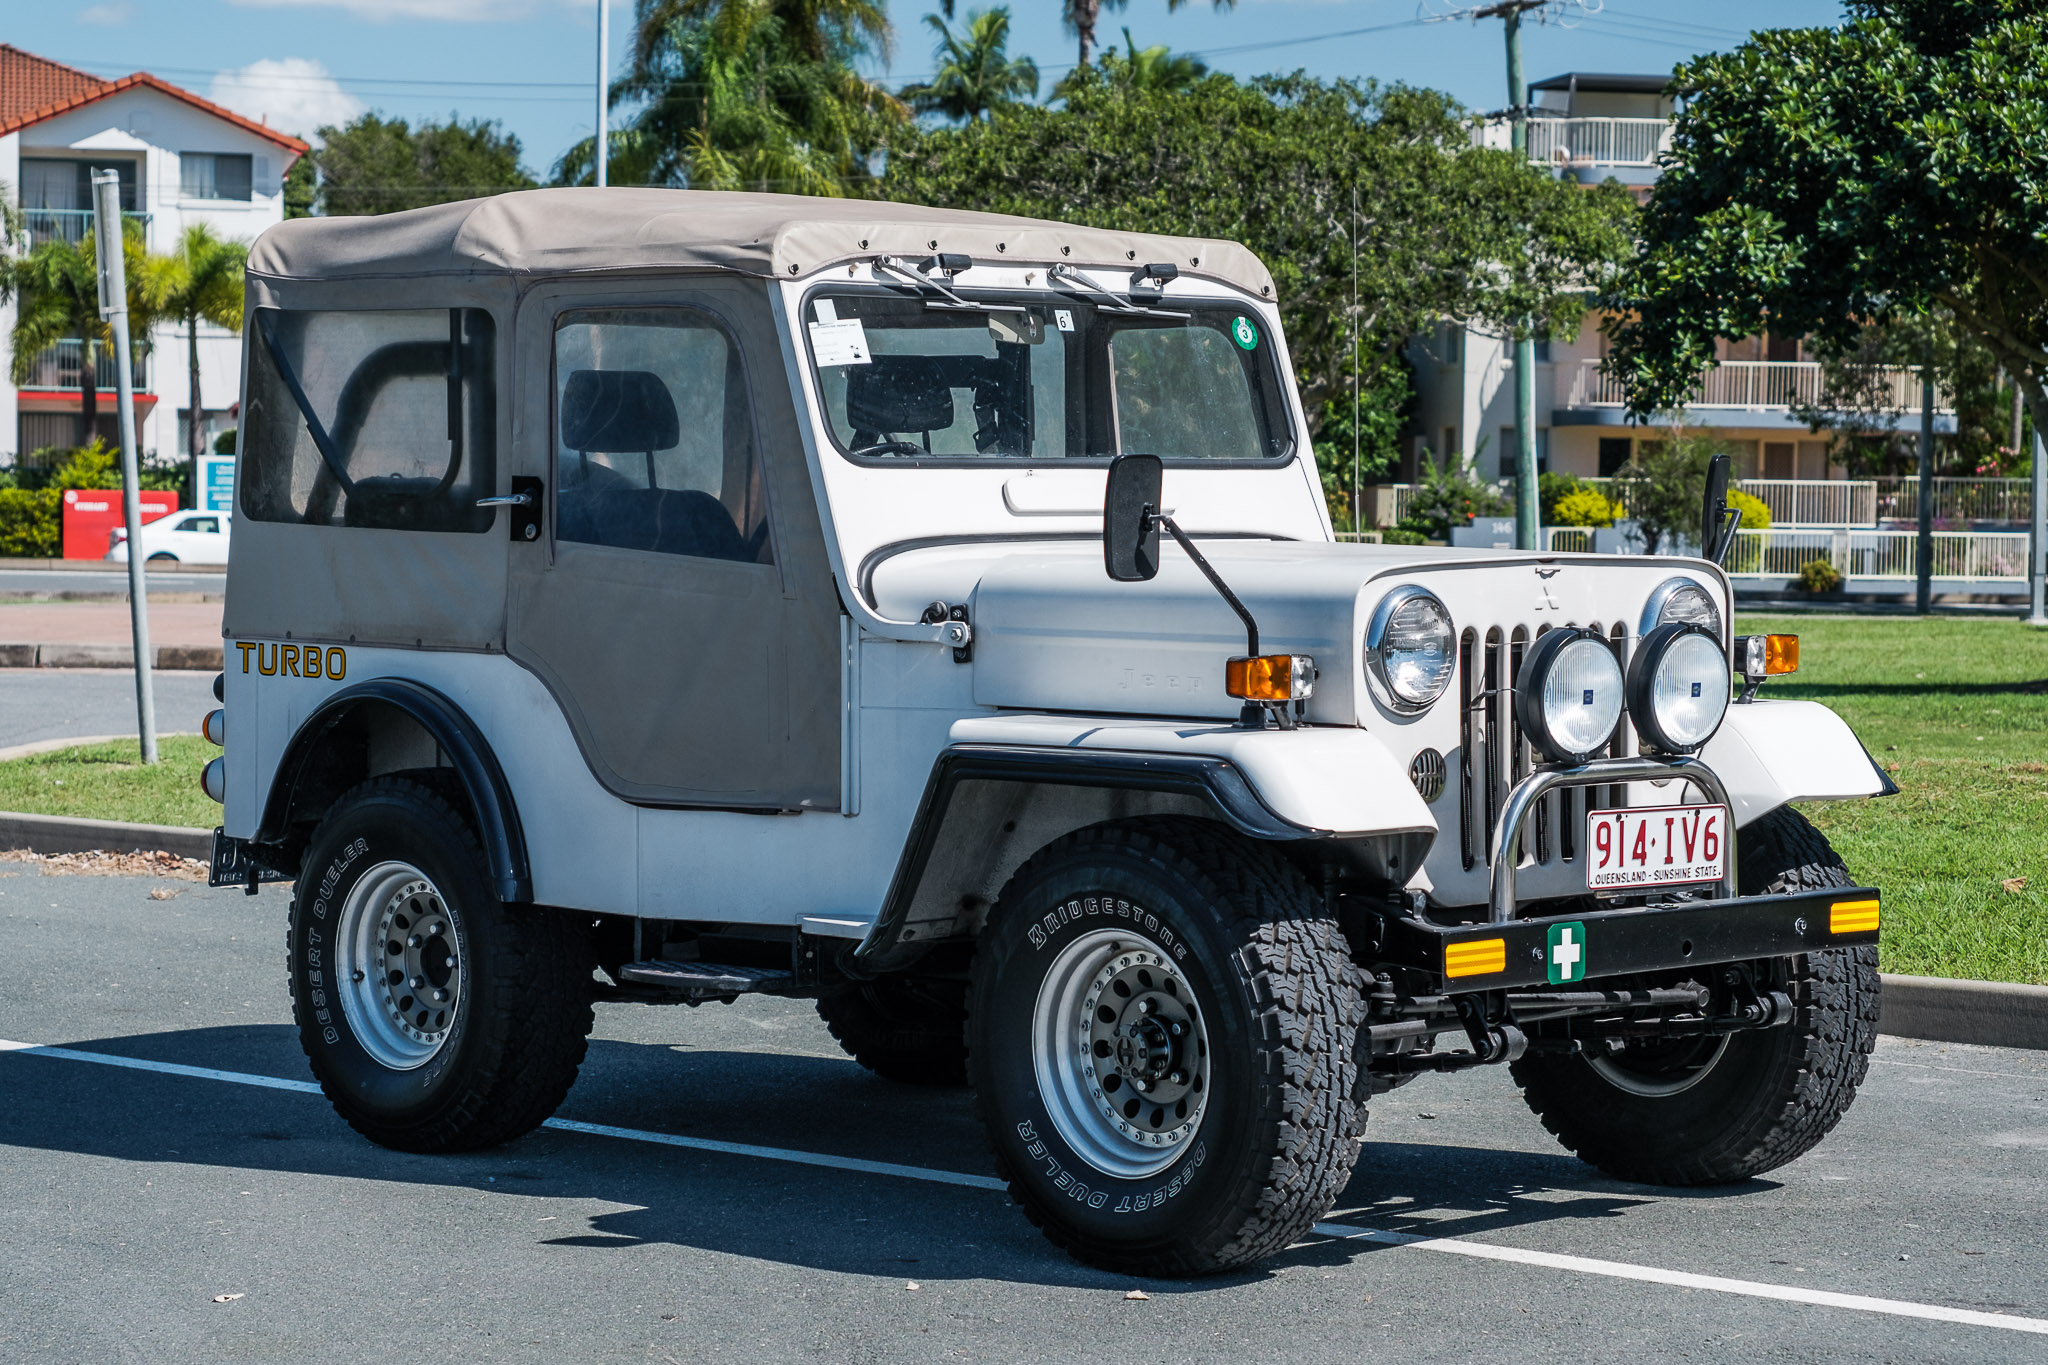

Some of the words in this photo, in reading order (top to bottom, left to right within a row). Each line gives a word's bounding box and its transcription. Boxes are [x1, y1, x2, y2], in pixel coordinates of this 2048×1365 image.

[1060, 316, 1067, 329] 6
[1242, 329, 1249, 340] 3
[236, 641, 347, 681] TURBO
[313, 837, 370, 920] DUELER
[1595, 871, 1647, 885] QUEENSLAND
[1653, 867, 1692, 881] SUNSHINE
[1695, 865, 1718, 878] STATE
[1027, 897, 1187, 961] BRIDGESTONE
[308, 927, 340, 1045] DESERT
[1017, 1119, 1109, 1210] DUELER
[1114, 1140, 1208, 1214] DESERT
